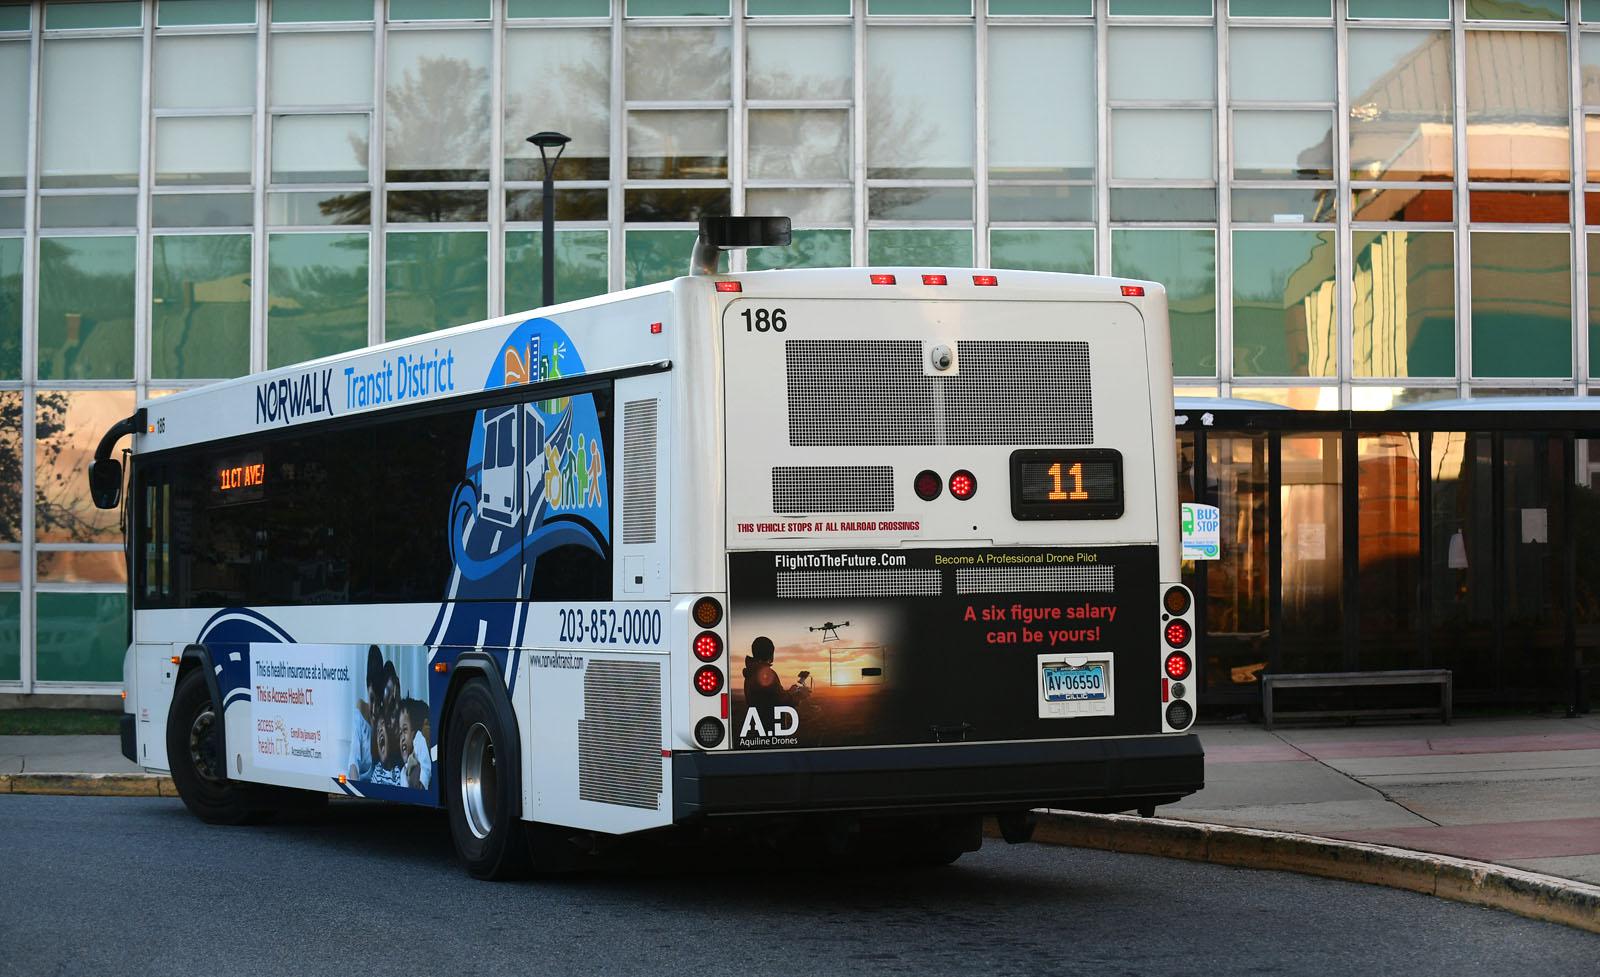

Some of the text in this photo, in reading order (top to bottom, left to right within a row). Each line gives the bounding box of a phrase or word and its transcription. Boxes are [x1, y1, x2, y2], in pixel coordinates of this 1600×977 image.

[741, 308, 787, 333] 186
[256, 348, 454, 425] NORWALK Transit District
[1048, 463, 1088, 500] 11
[1197, 508, 1218, 520] BUS
[737, 521, 920, 533] THIS VEHICLE STOPS AT ALL RAILROAD CROSSINGS
[1197, 520, 1219, 532] STOP
[775, 553, 907, 570] FlightToTheFuture.Com
[935, 552, 1097, 564] Become A Professional Drone Pilot
[964, 602, 1117, 624] A six figure salary
[559, 608, 661, 645] 203-852-0000
[986, 626, 1101, 646] can be yours!
[256, 660, 266, 677] This
[271, 661, 286, 678] health
[287, 662, 311, 680] insurance
[312, 665, 317, 680] at
[322, 663, 336, 680] lower
[337, 665, 350, 681] cost.
[529, 652, 584, 669] www.norwalktransit.com
[256, 685, 266, 702] This
[272, 688, 287, 703] Access
[288, 688, 305, 705] Health
[740, 736, 798, 747] Aquiline Drones
